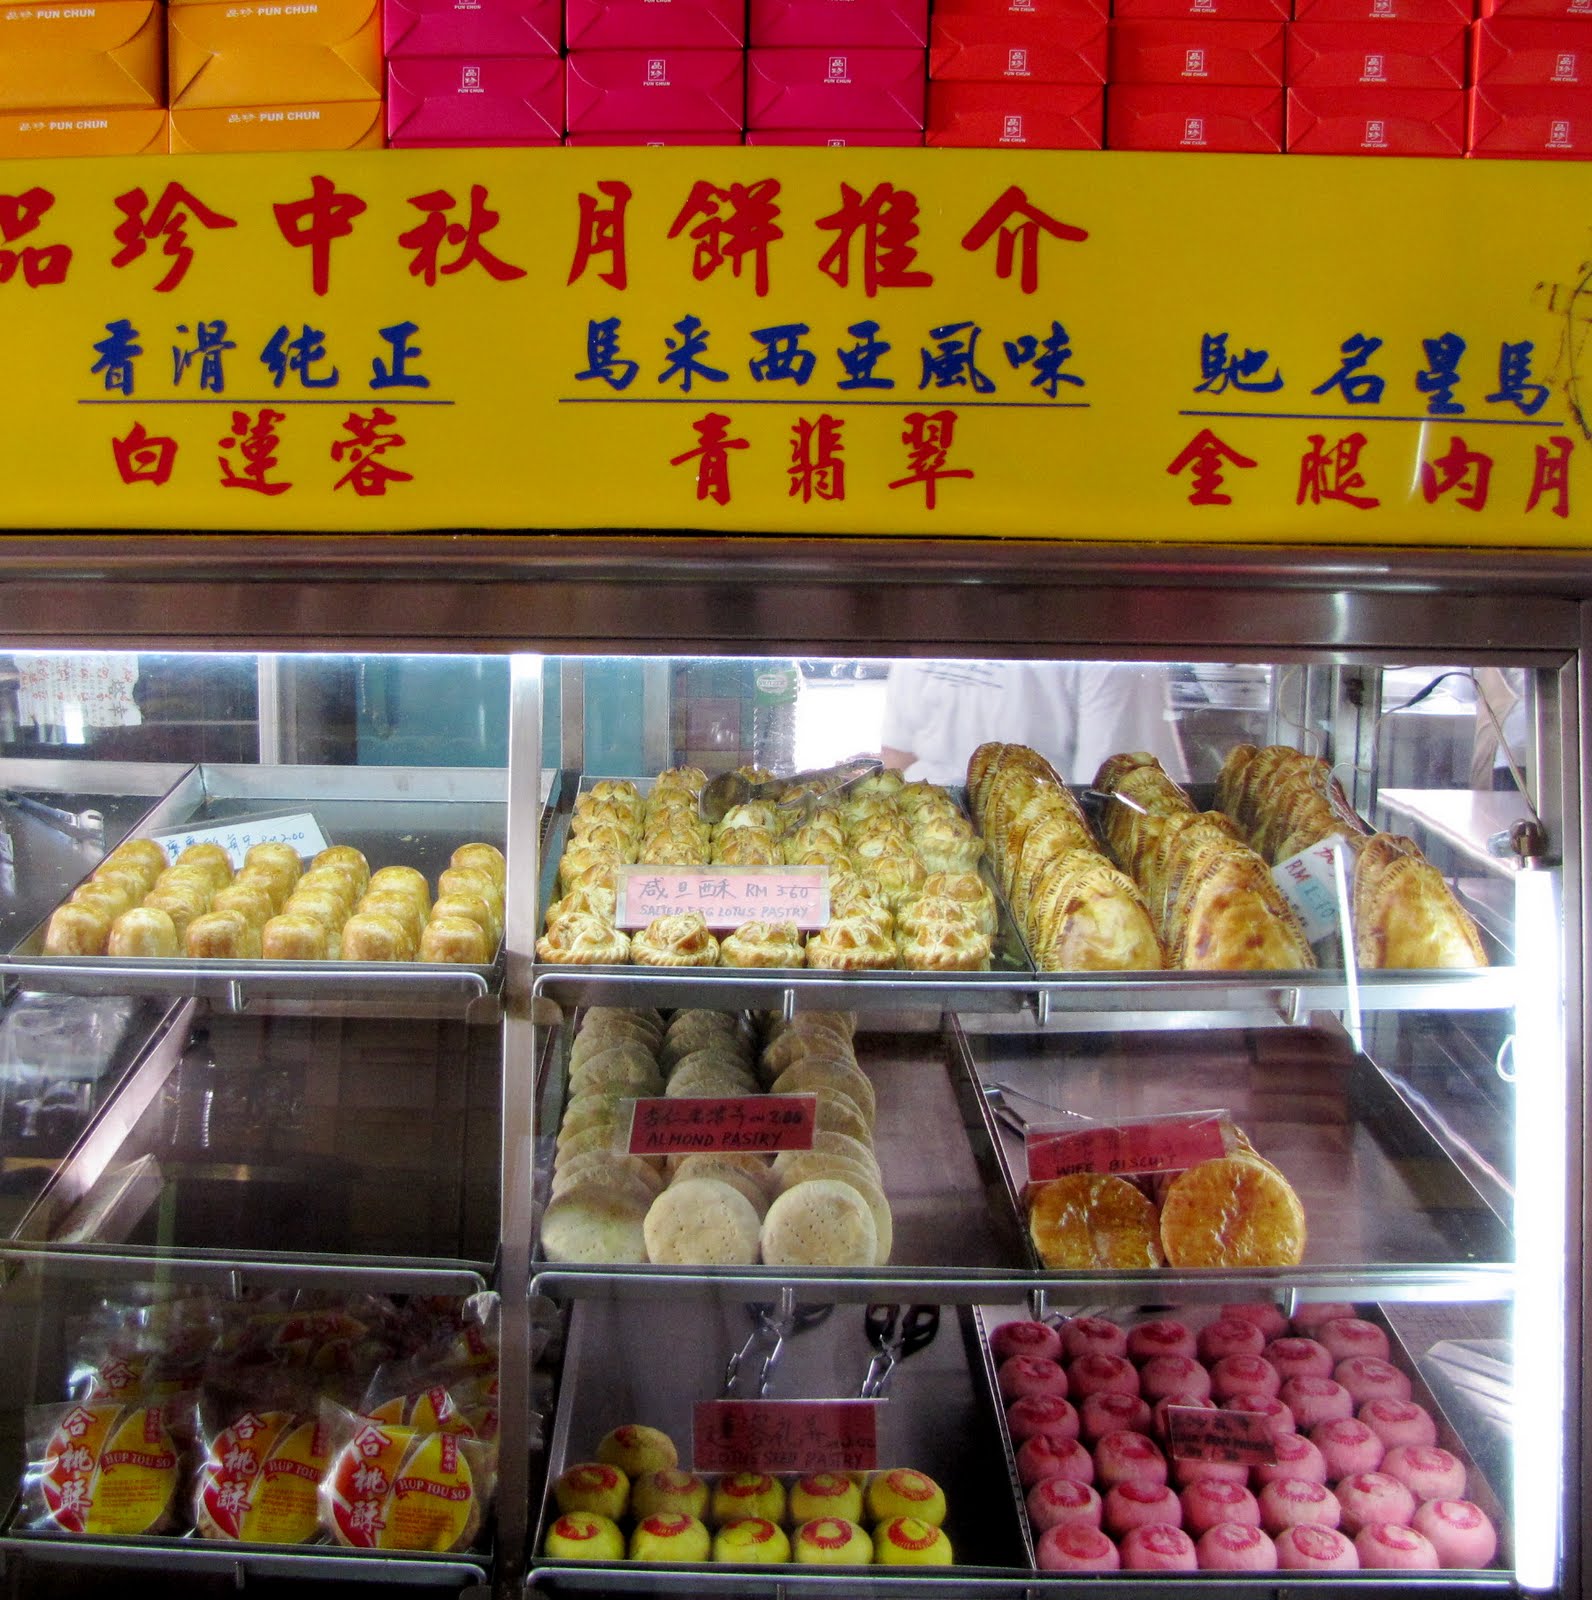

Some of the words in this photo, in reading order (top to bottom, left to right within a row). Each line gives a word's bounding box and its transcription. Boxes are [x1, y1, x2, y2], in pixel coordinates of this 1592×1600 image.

[37, 10, 60, 19] PUN
[63, 9, 95, 18] CHUN
[258, 7, 281, 16] PUN
[285, 5, 318, 15] CHUN
[259, 112, 283, 121] PUN
[287, 111, 320, 120] CHUN
[49, 121, 73, 130] PUN
[76, 119, 108, 129] CHUN
[112, 407, 414, 497] 白蓮蓉
[671, 409, 975, 511] 青翡翠
[746, 882, 768, 898] RM
[718, 904, 757, 918] LOTUS
[761, 904, 809, 919] PASTRY
[646, 1131, 714, 1147] ALMOND
[722, 1130, 783, 1147] PASTRY
[1056, 1163, 1095, 1176] WIFE
[105, 1452, 129, 1466] HUP
[155, 1456, 172, 1467] SO
[268, 1459, 293, 1475] HUP
[399, 1479, 424, 1492] HUP
[427, 1483, 450, 1497] TOU
[451, 1488, 467, 1500] SO
